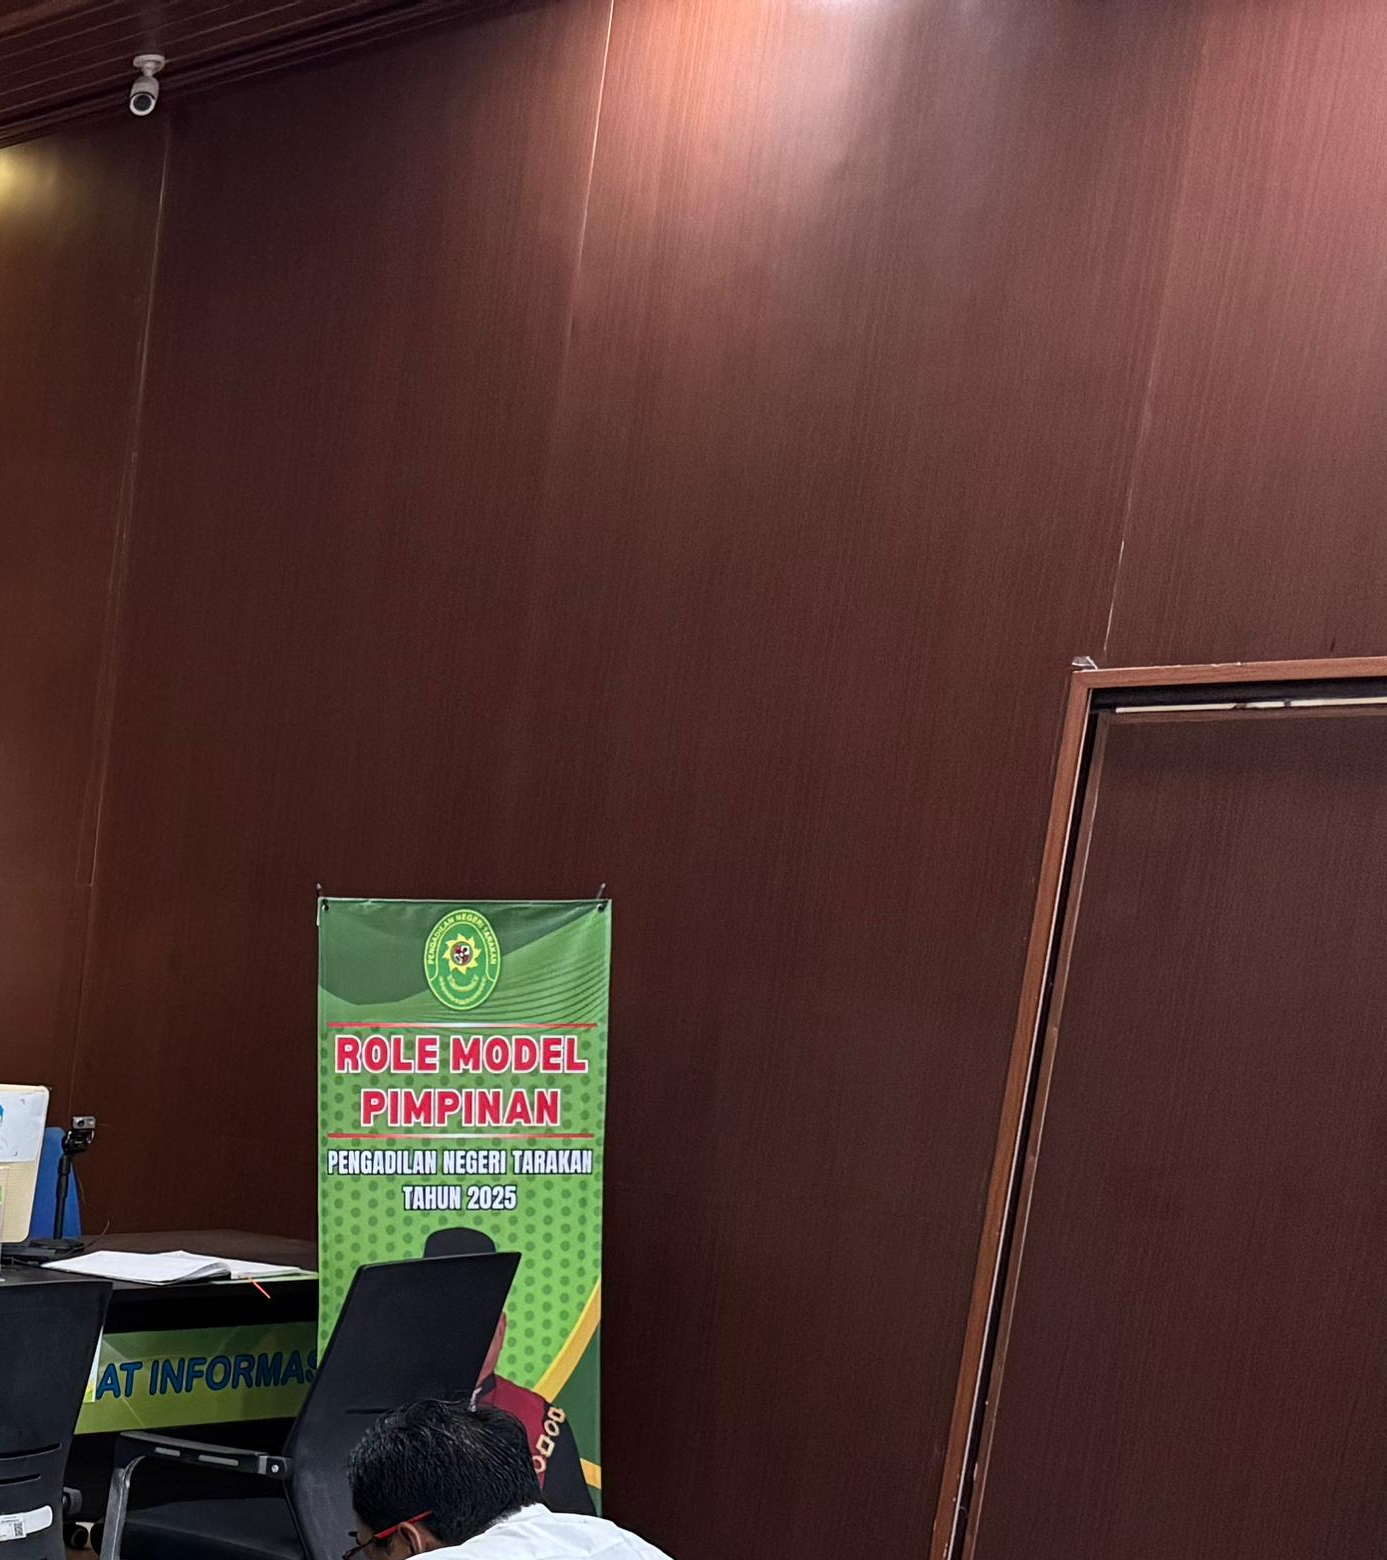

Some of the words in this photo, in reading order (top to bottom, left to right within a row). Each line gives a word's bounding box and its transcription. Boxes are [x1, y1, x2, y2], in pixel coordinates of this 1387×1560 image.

[335, 1034, 440, 1073] ROLE
[450, 1034, 588, 1073] MODEL
[360, 1088, 561, 1126] PIMPINAN
[328, 1149, 437, 1175] PENGADILAN
[443, 1149, 507, 1175] NEGERI
[512, 1149, 593, 1176] TARAKAN
[403, 1185, 462, 1211] TAHUN
[467, 1185, 517, 1211] 2025
